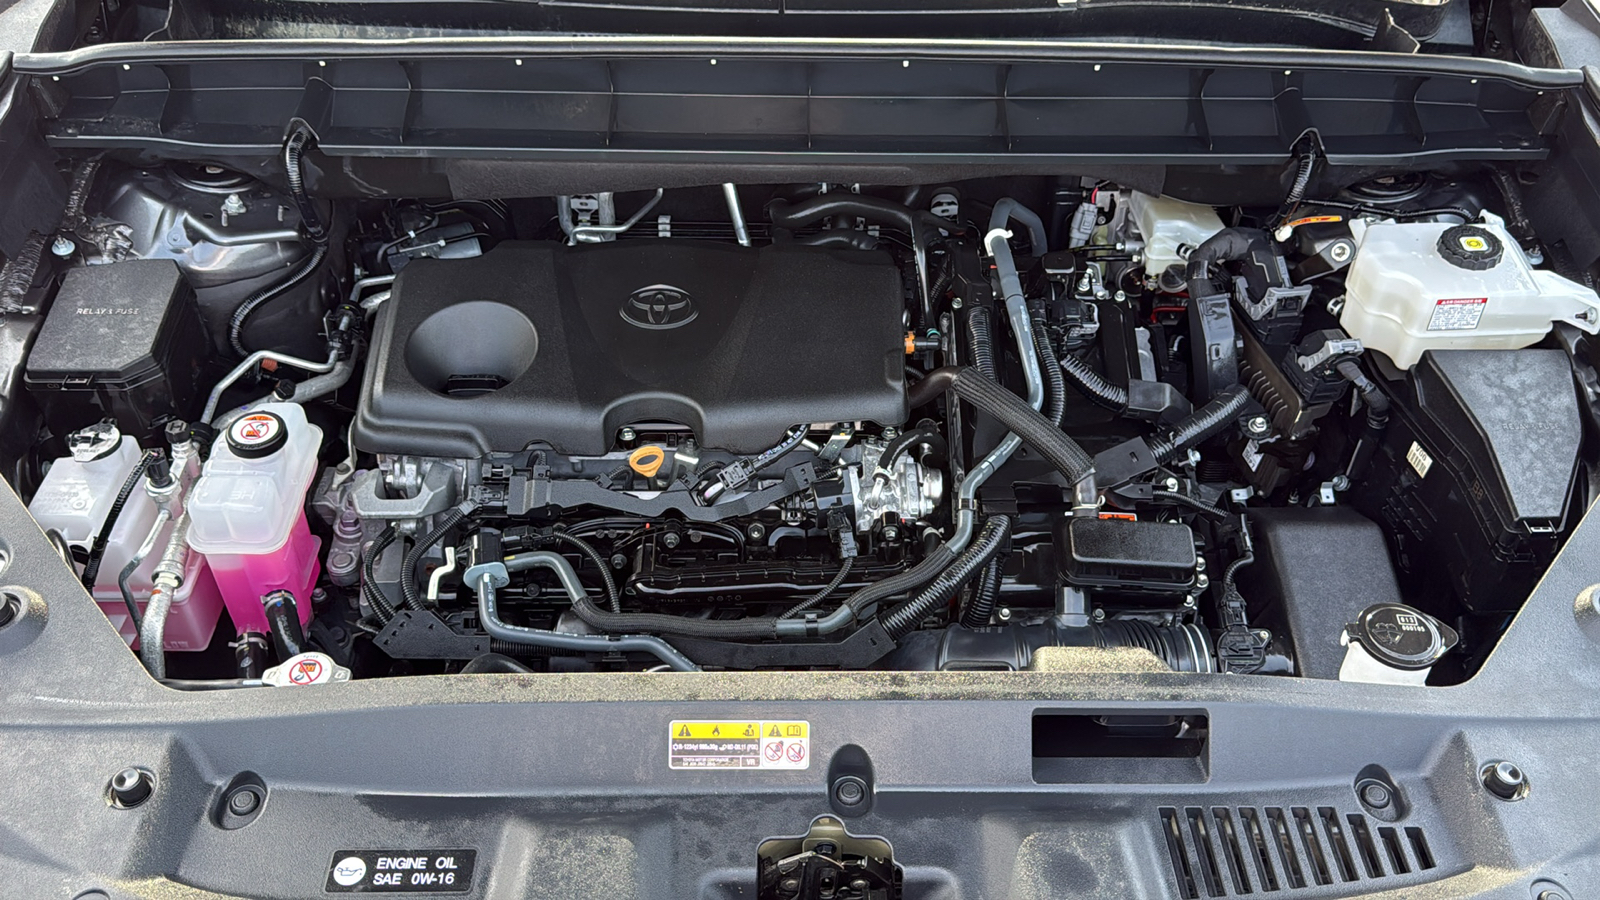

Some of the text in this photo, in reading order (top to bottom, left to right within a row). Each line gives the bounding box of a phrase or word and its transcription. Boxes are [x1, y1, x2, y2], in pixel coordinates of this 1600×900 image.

[376, 857, 458, 870] ENGINE OIL
[373, 872, 455, 885] SAE 0W-16
